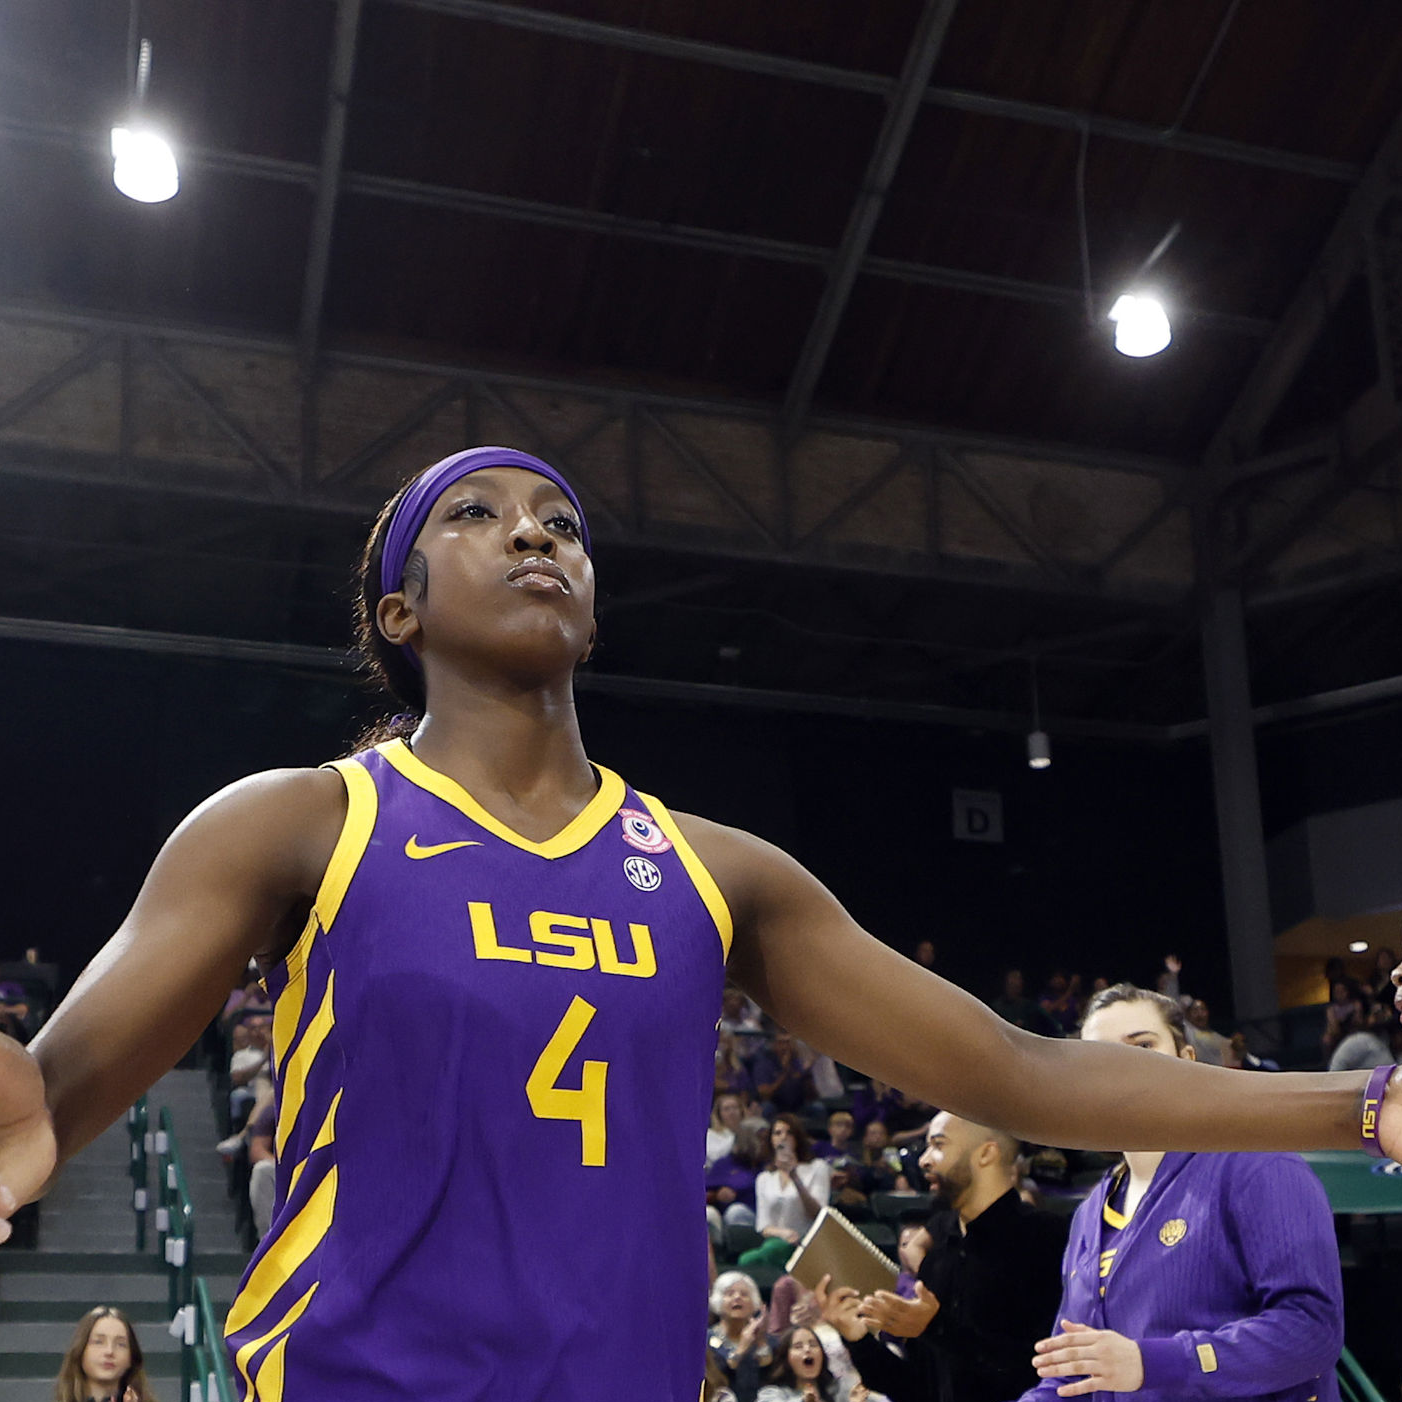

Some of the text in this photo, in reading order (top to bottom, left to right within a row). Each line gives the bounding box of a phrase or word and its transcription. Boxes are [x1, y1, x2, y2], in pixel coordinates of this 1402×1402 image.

[966, 805, 990, 834] D
[626, 858, 659, 889] SEC
[467, 901, 658, 978] LSU
[525, 994, 609, 1167] 4
[1362, 1099, 1378, 1139] LSU
